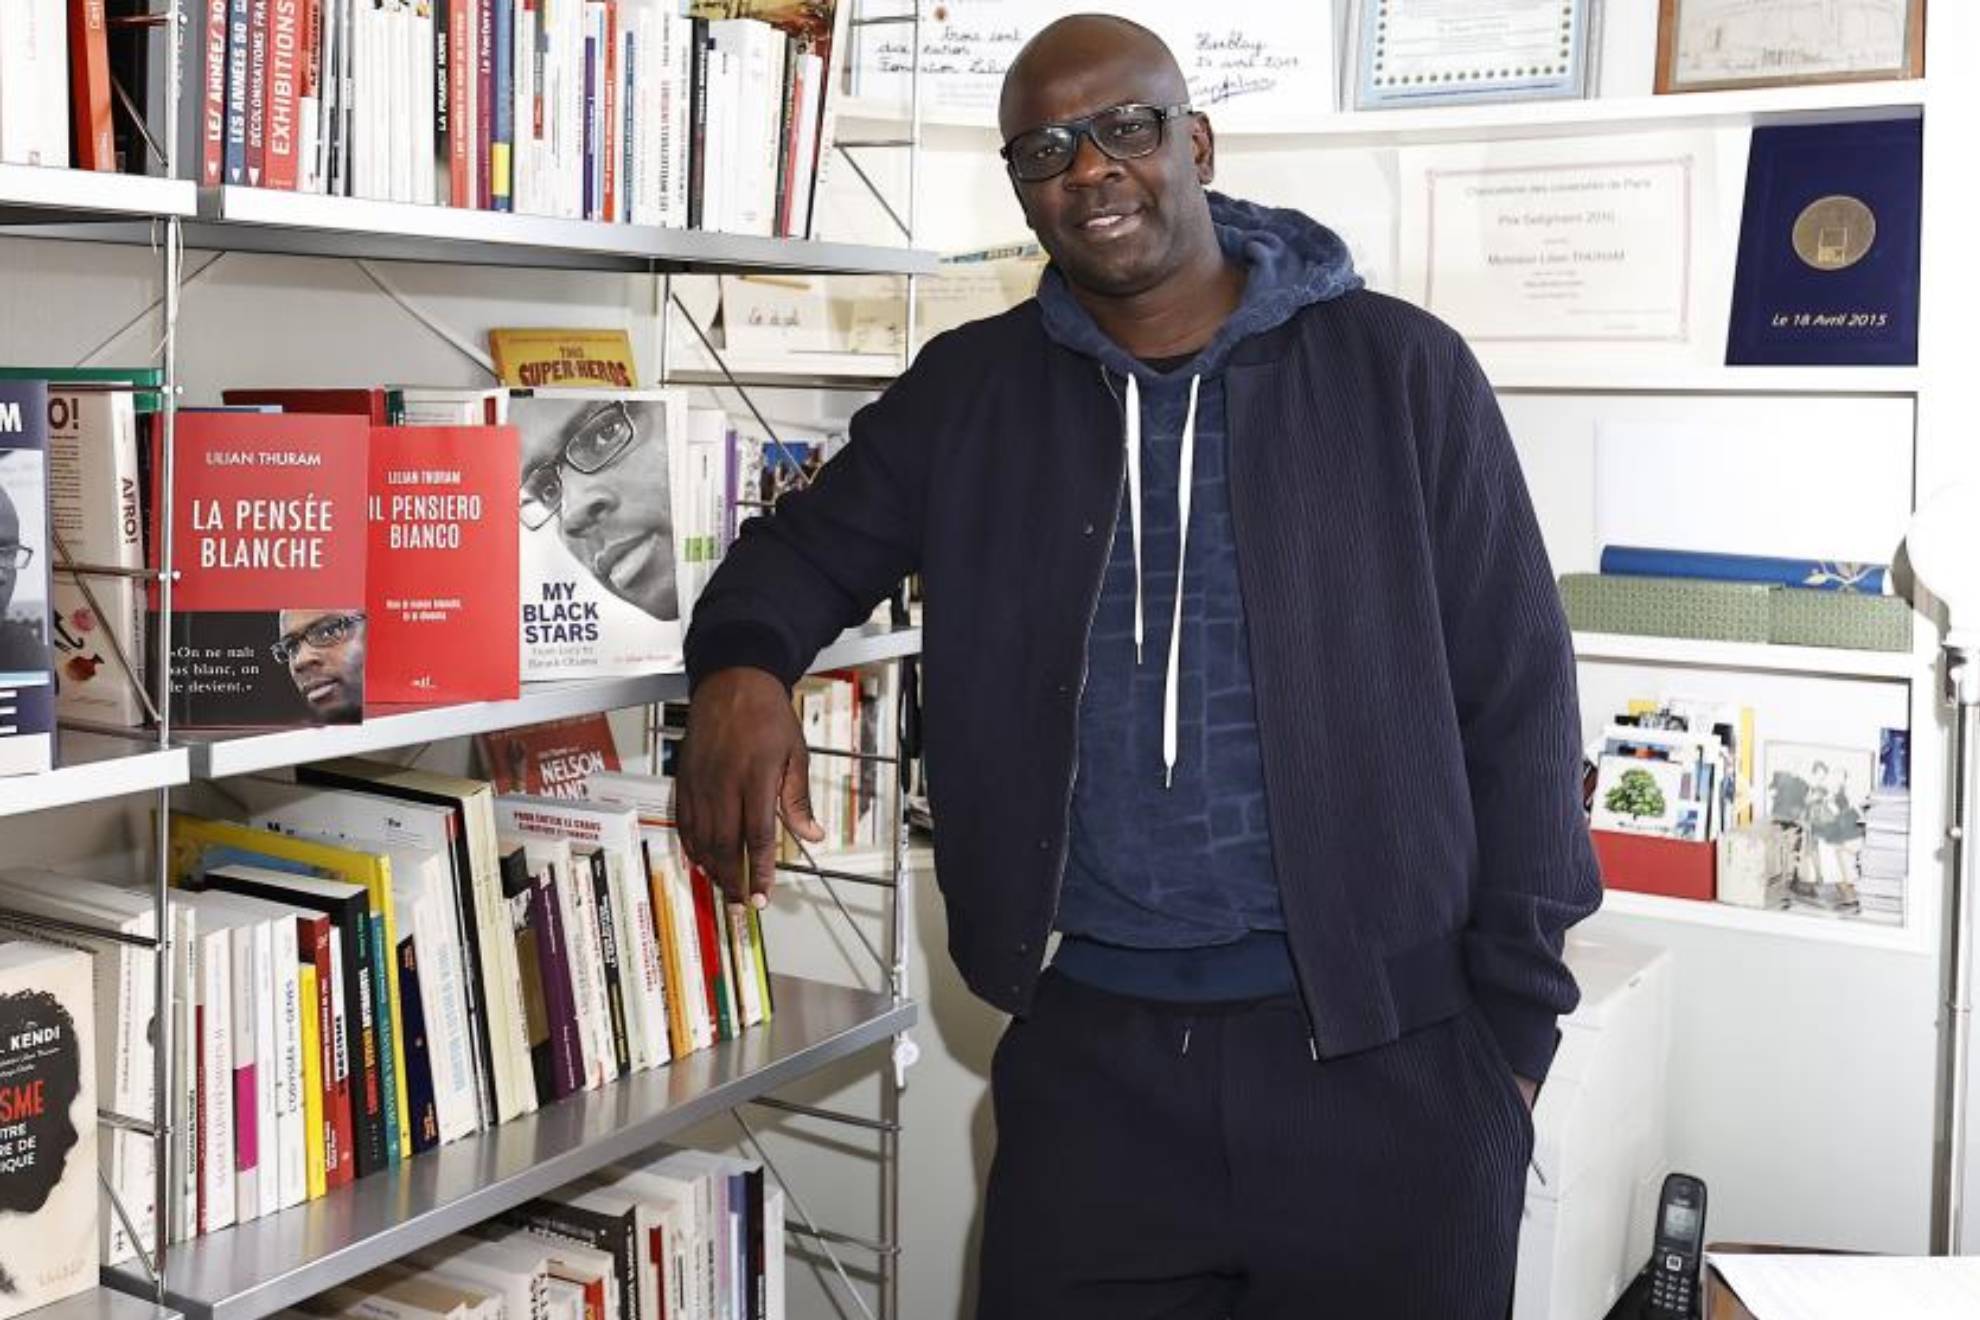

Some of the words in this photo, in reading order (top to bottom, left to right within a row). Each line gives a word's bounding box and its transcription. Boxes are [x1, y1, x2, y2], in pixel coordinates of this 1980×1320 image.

[207, 30, 226, 104] ANNÉES
[270, 0, 296, 156] EXHIBITIONS
[437, 68, 448, 113] FRANCE
[207, 106, 222, 142] LES
[230, 114, 246, 144] LES
[437, 115, 448, 132] LA
[1771, 312, 1789, 327] Le
[1812, 312, 1847, 327] Avril
[1847, 312, 1889, 327] 2015
[204, 450, 256, 466] LILIAN
[258, 450, 322, 466] THURAM
[192, 498, 225, 531] LA
[235, 490, 337, 533] PENSÉE
[367, 494, 385, 522] IL
[391, 493, 482, 522] PENSIERO
[389, 522, 461, 550] BIANCO
[201, 536, 324, 569] BLANCHE
[541, 581, 577, 602] MY
[522, 601, 601, 624] BLACK
[524, 622, 600, 645] STARS
[204, 648, 223, 660] ne
[193, 661, 237, 679] blanc,
[240, 663, 261, 676] on
[539, 750, 606, 785] NELSON
[10, 1025, 61, 1051] KENDI
[17, 1135, 37, 1153] DE
